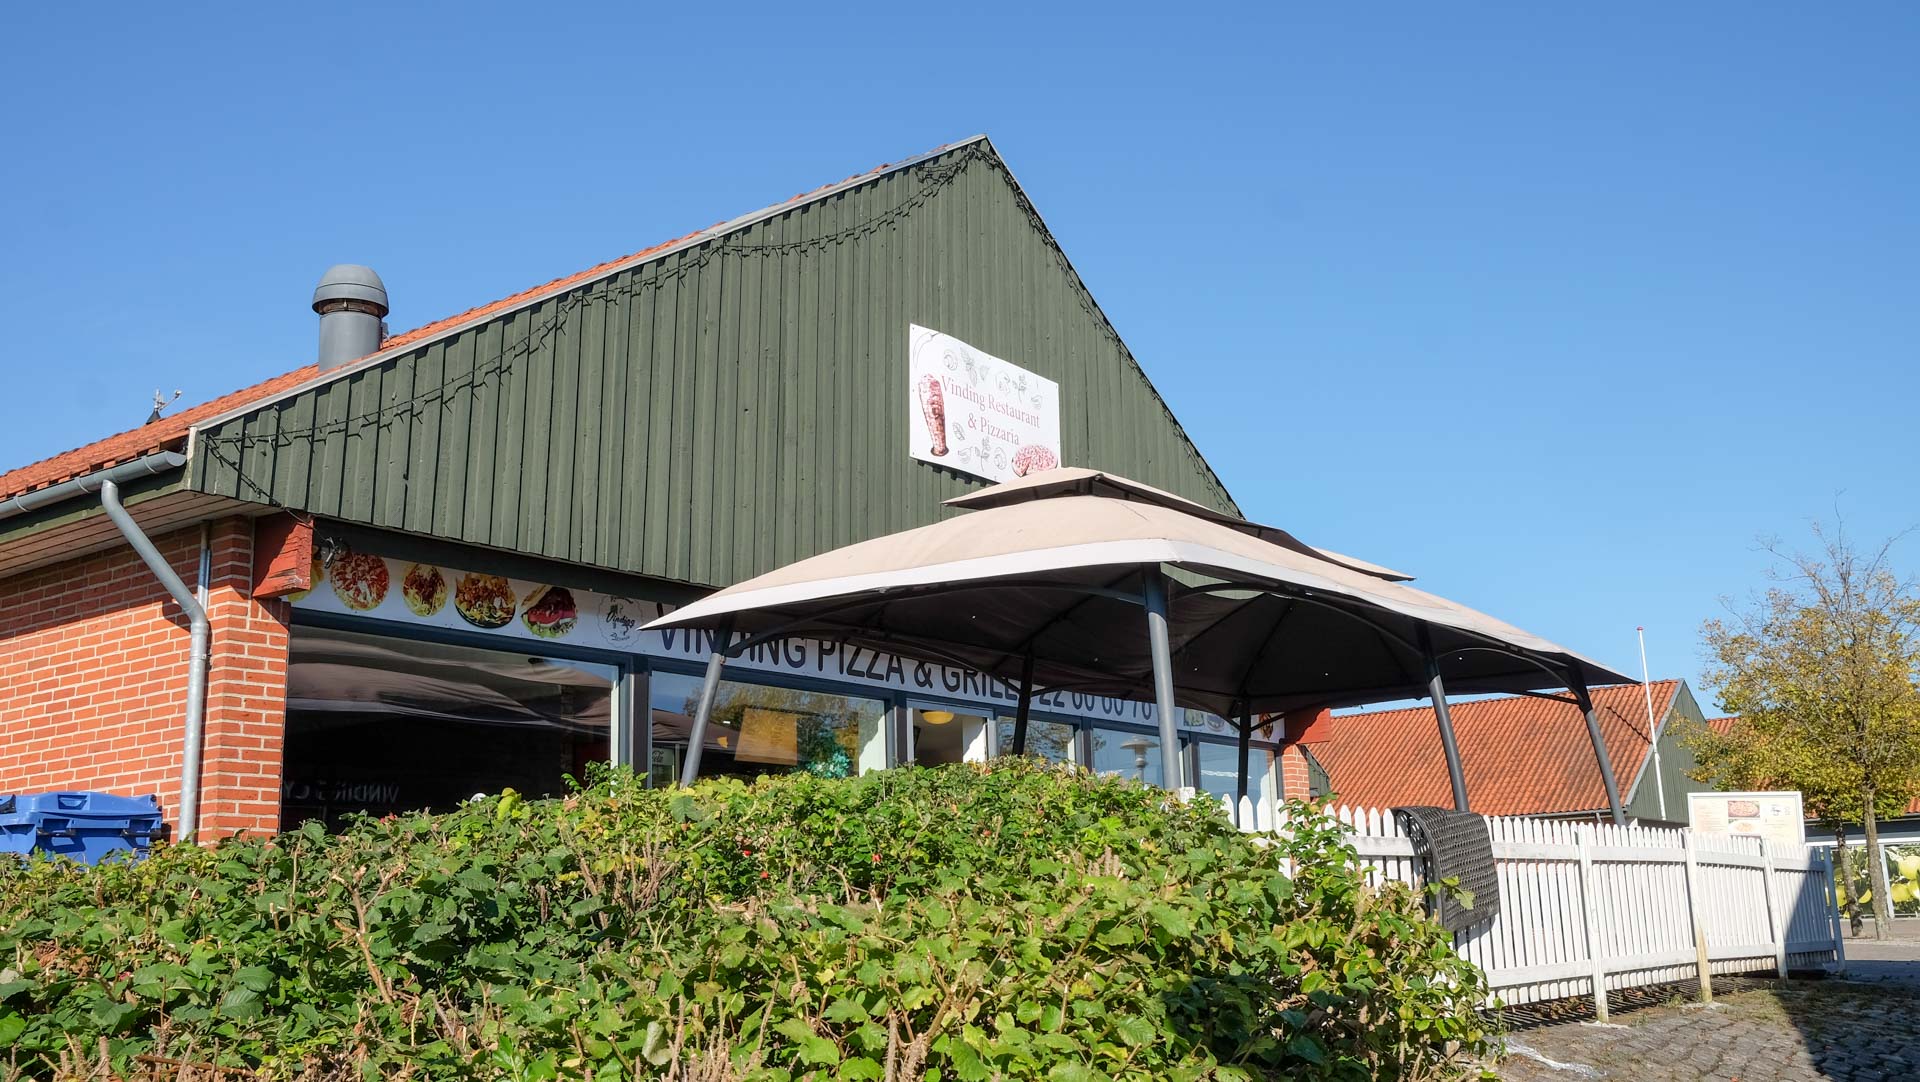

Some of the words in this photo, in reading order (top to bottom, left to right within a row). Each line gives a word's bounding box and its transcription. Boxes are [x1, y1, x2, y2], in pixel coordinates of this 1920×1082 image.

[941, 375, 986, 411] Vinding
[988, 393, 1041, 429] Restaurant
[967, 412, 977, 431] &
[980, 416, 1020, 446] Pizzaria
[818, 639, 905, 685] PIZZA
[914, 660, 933, 689] &
